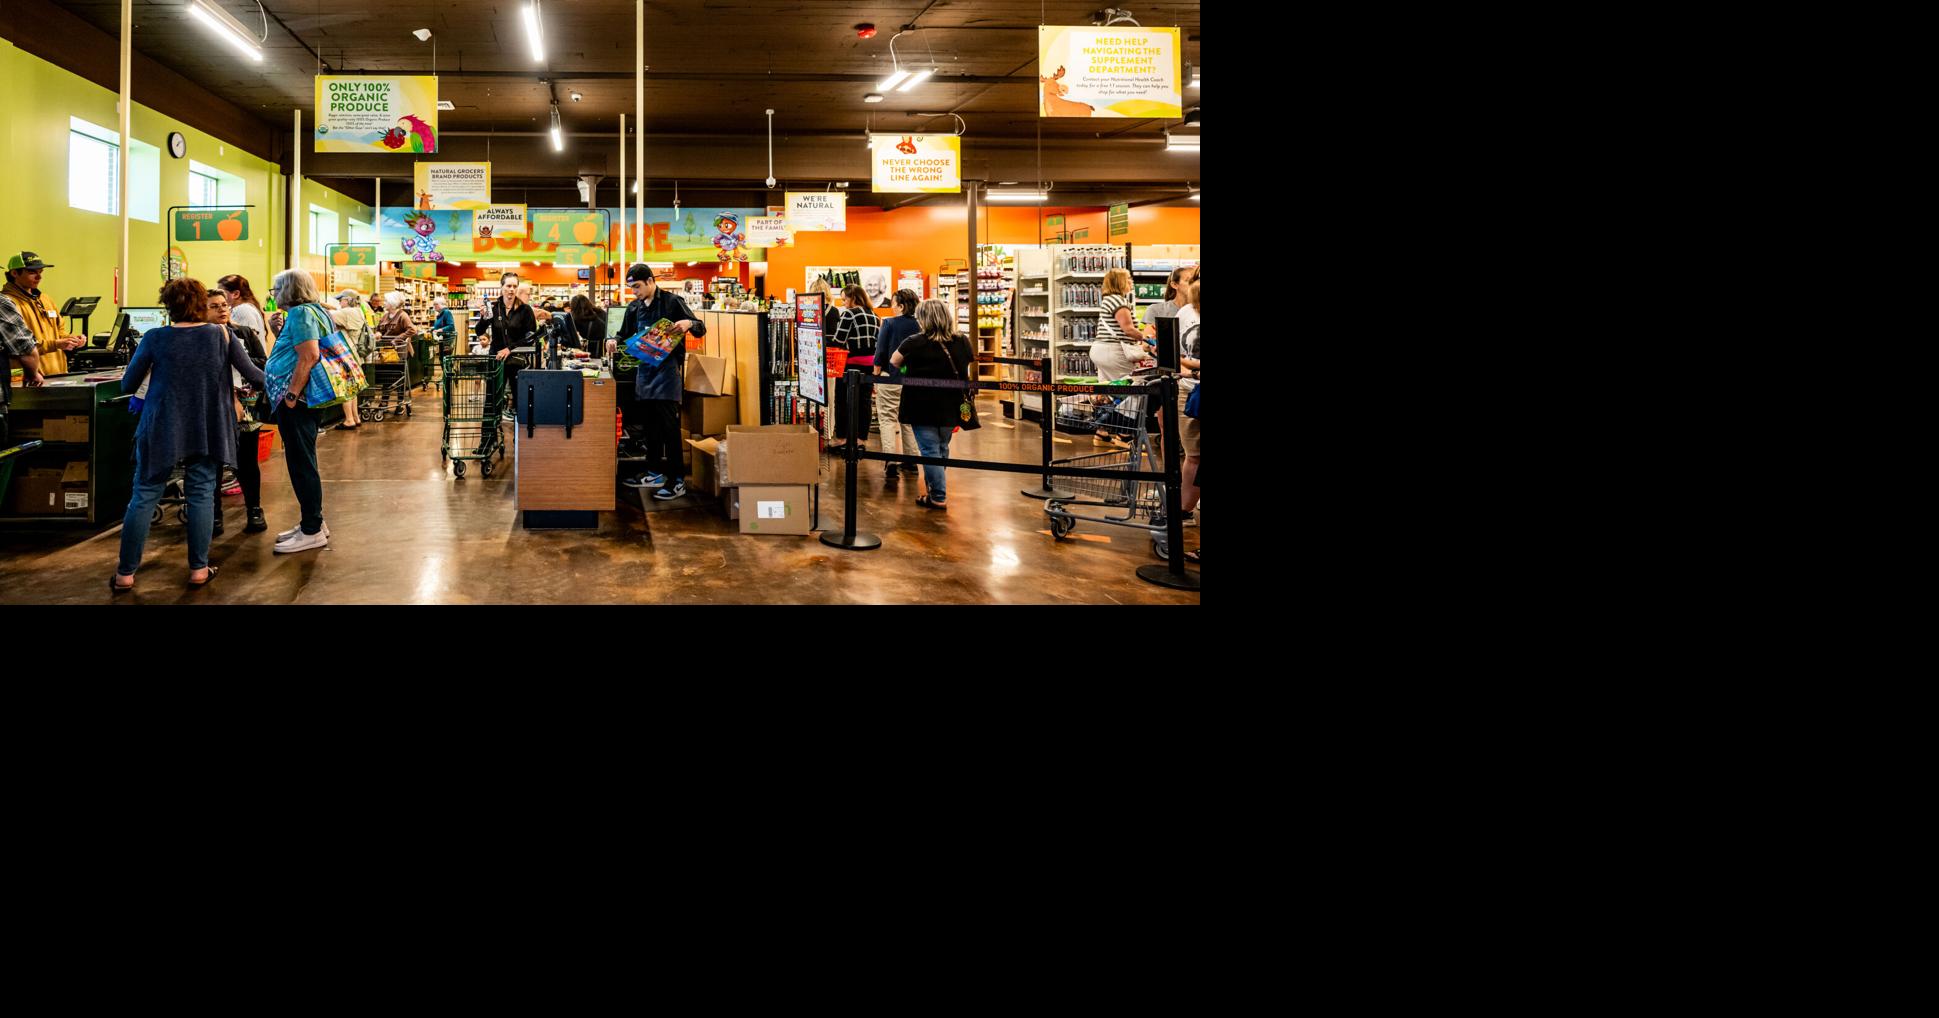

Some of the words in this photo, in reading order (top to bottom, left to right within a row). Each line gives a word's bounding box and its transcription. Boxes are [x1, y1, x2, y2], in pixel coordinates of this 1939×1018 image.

[1095, 38, 1122, 46] NEED
[1124, 38, 1148, 46] HELP
[1089, 66, 1156, 74] DEPARTMENT?
[329, 82, 361, 91] ONLY
[363, 82, 390, 91] 100%
[331, 93, 387, 102] ORGANIC
[330, 103, 388, 112] PRODUCE
[192, 222, 200, 240] 1
[548, 223, 560, 240] 4
[999, 382, 1020, 390] 100%
[1022, 383, 1056, 392] ORGANIC
[1057, 385, 1095, 393] PRODUCE
